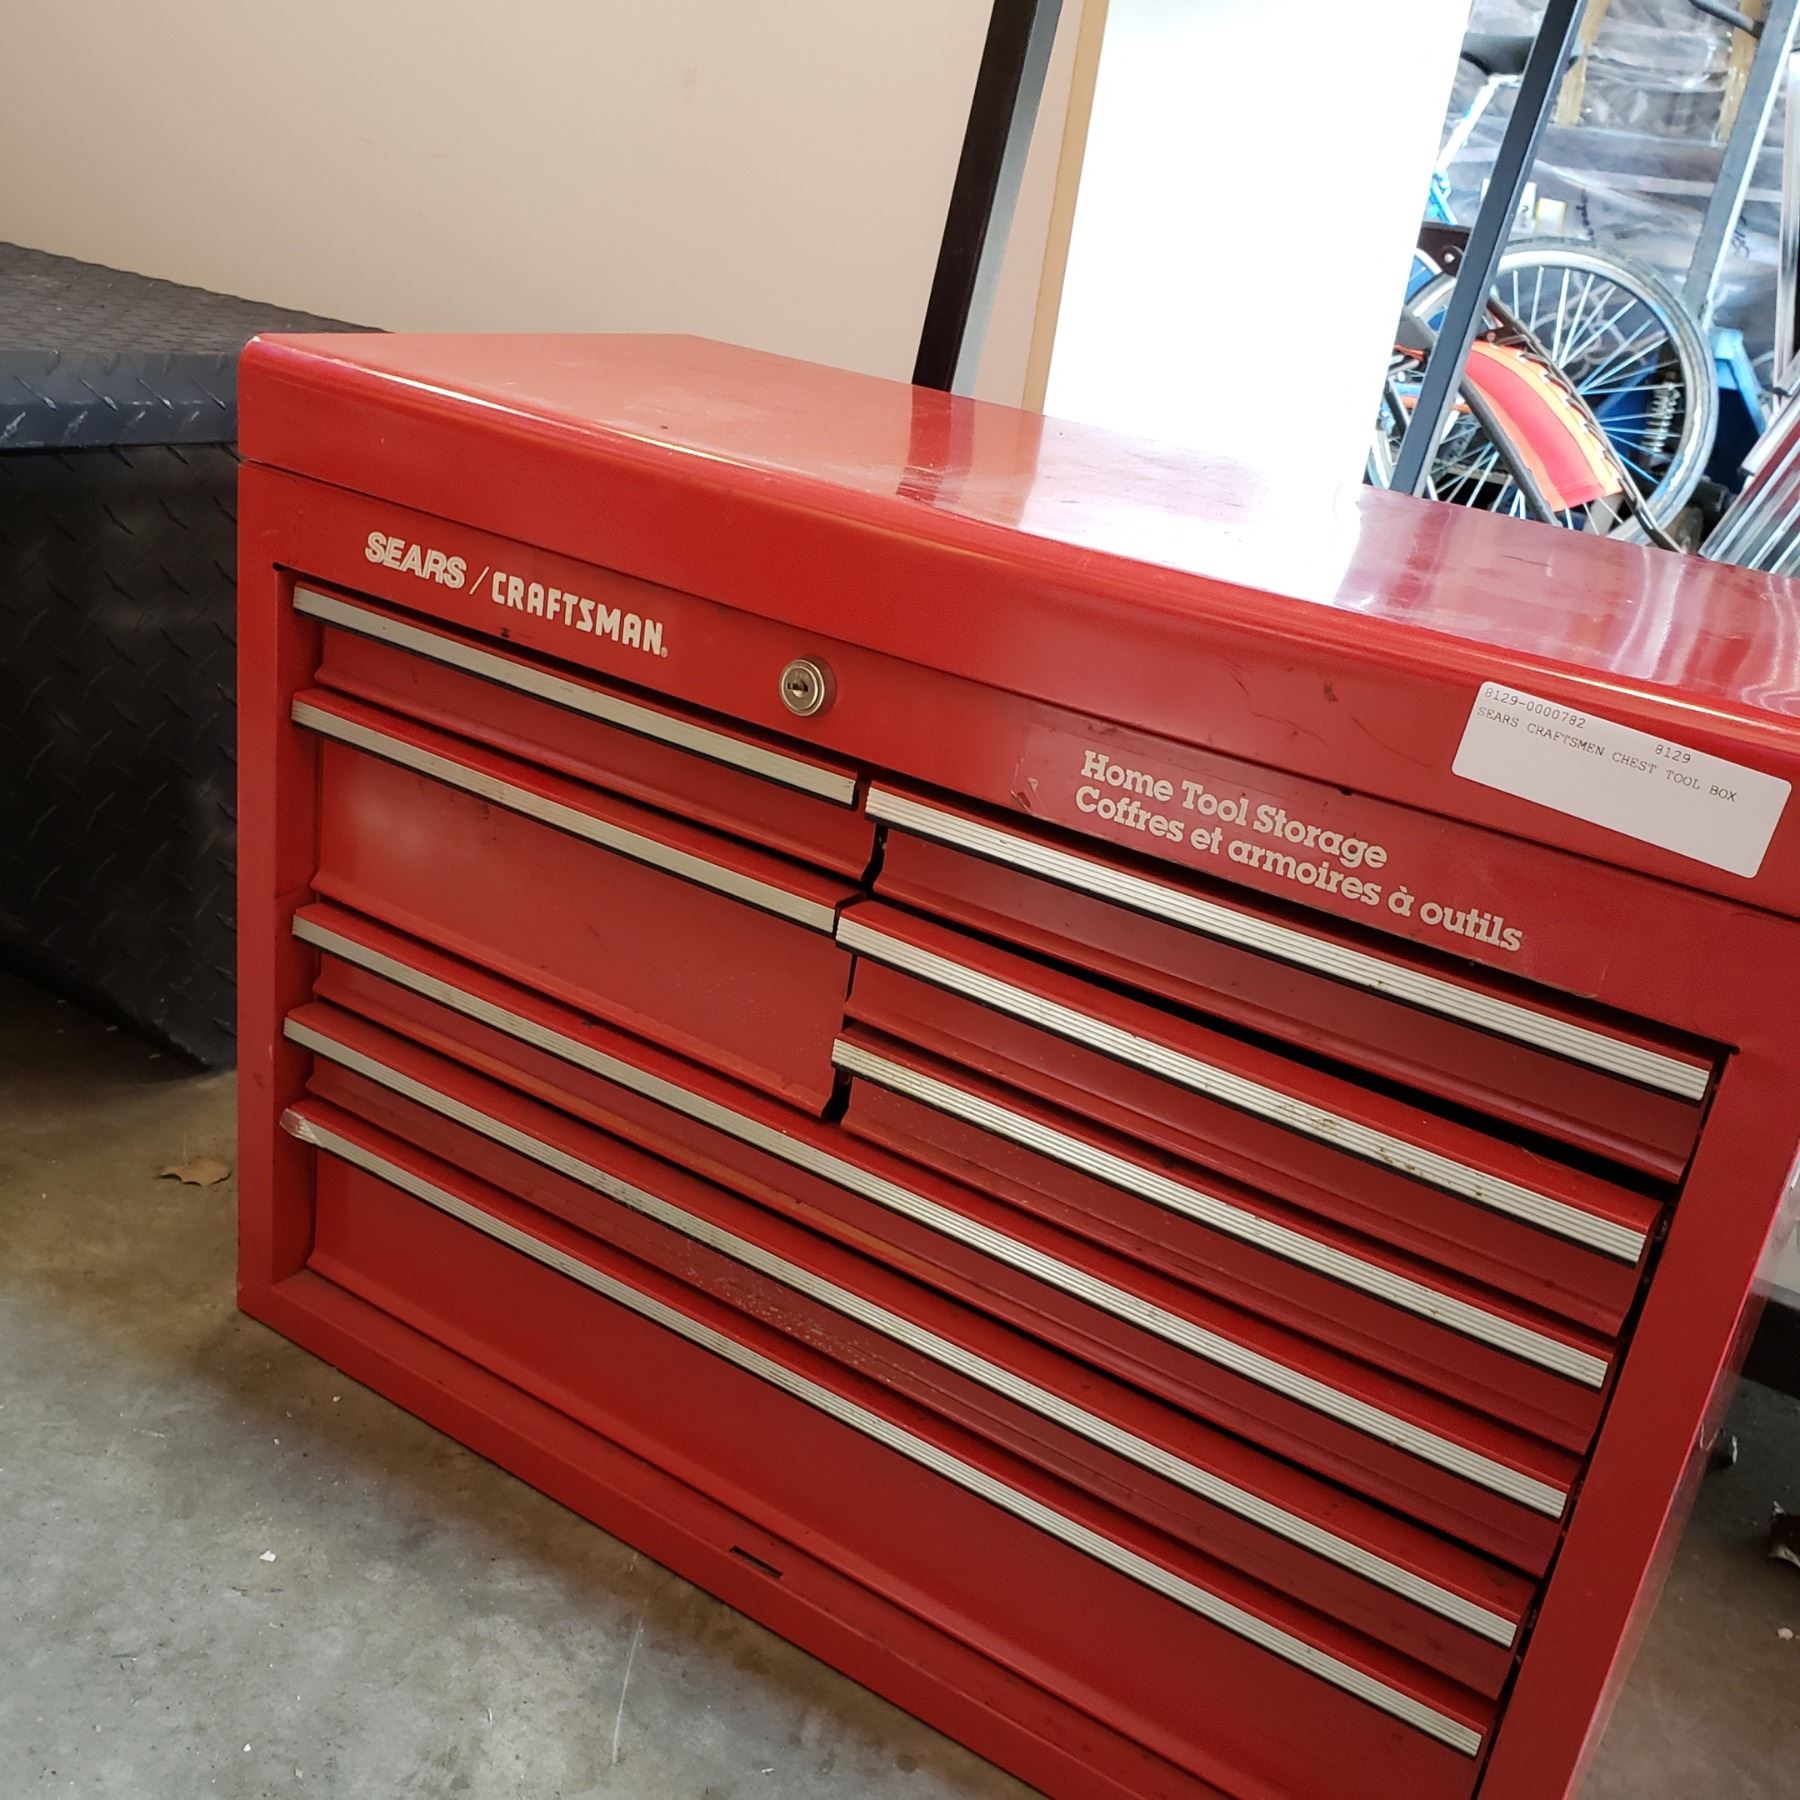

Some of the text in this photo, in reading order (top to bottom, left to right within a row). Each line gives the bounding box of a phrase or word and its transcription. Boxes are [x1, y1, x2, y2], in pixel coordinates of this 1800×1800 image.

[365, 532, 467, 589] SEARS
[1477, 706, 1738, 802] SEARS CRAFTSMEN CHEST TOOL BOX
[1485, 687, 1692, 764] 8129-0000782 8129
[1081, 750, 1388, 869] Home Tool Storage
[1075, 786, 1523, 952] Coffres et armoires à outils
